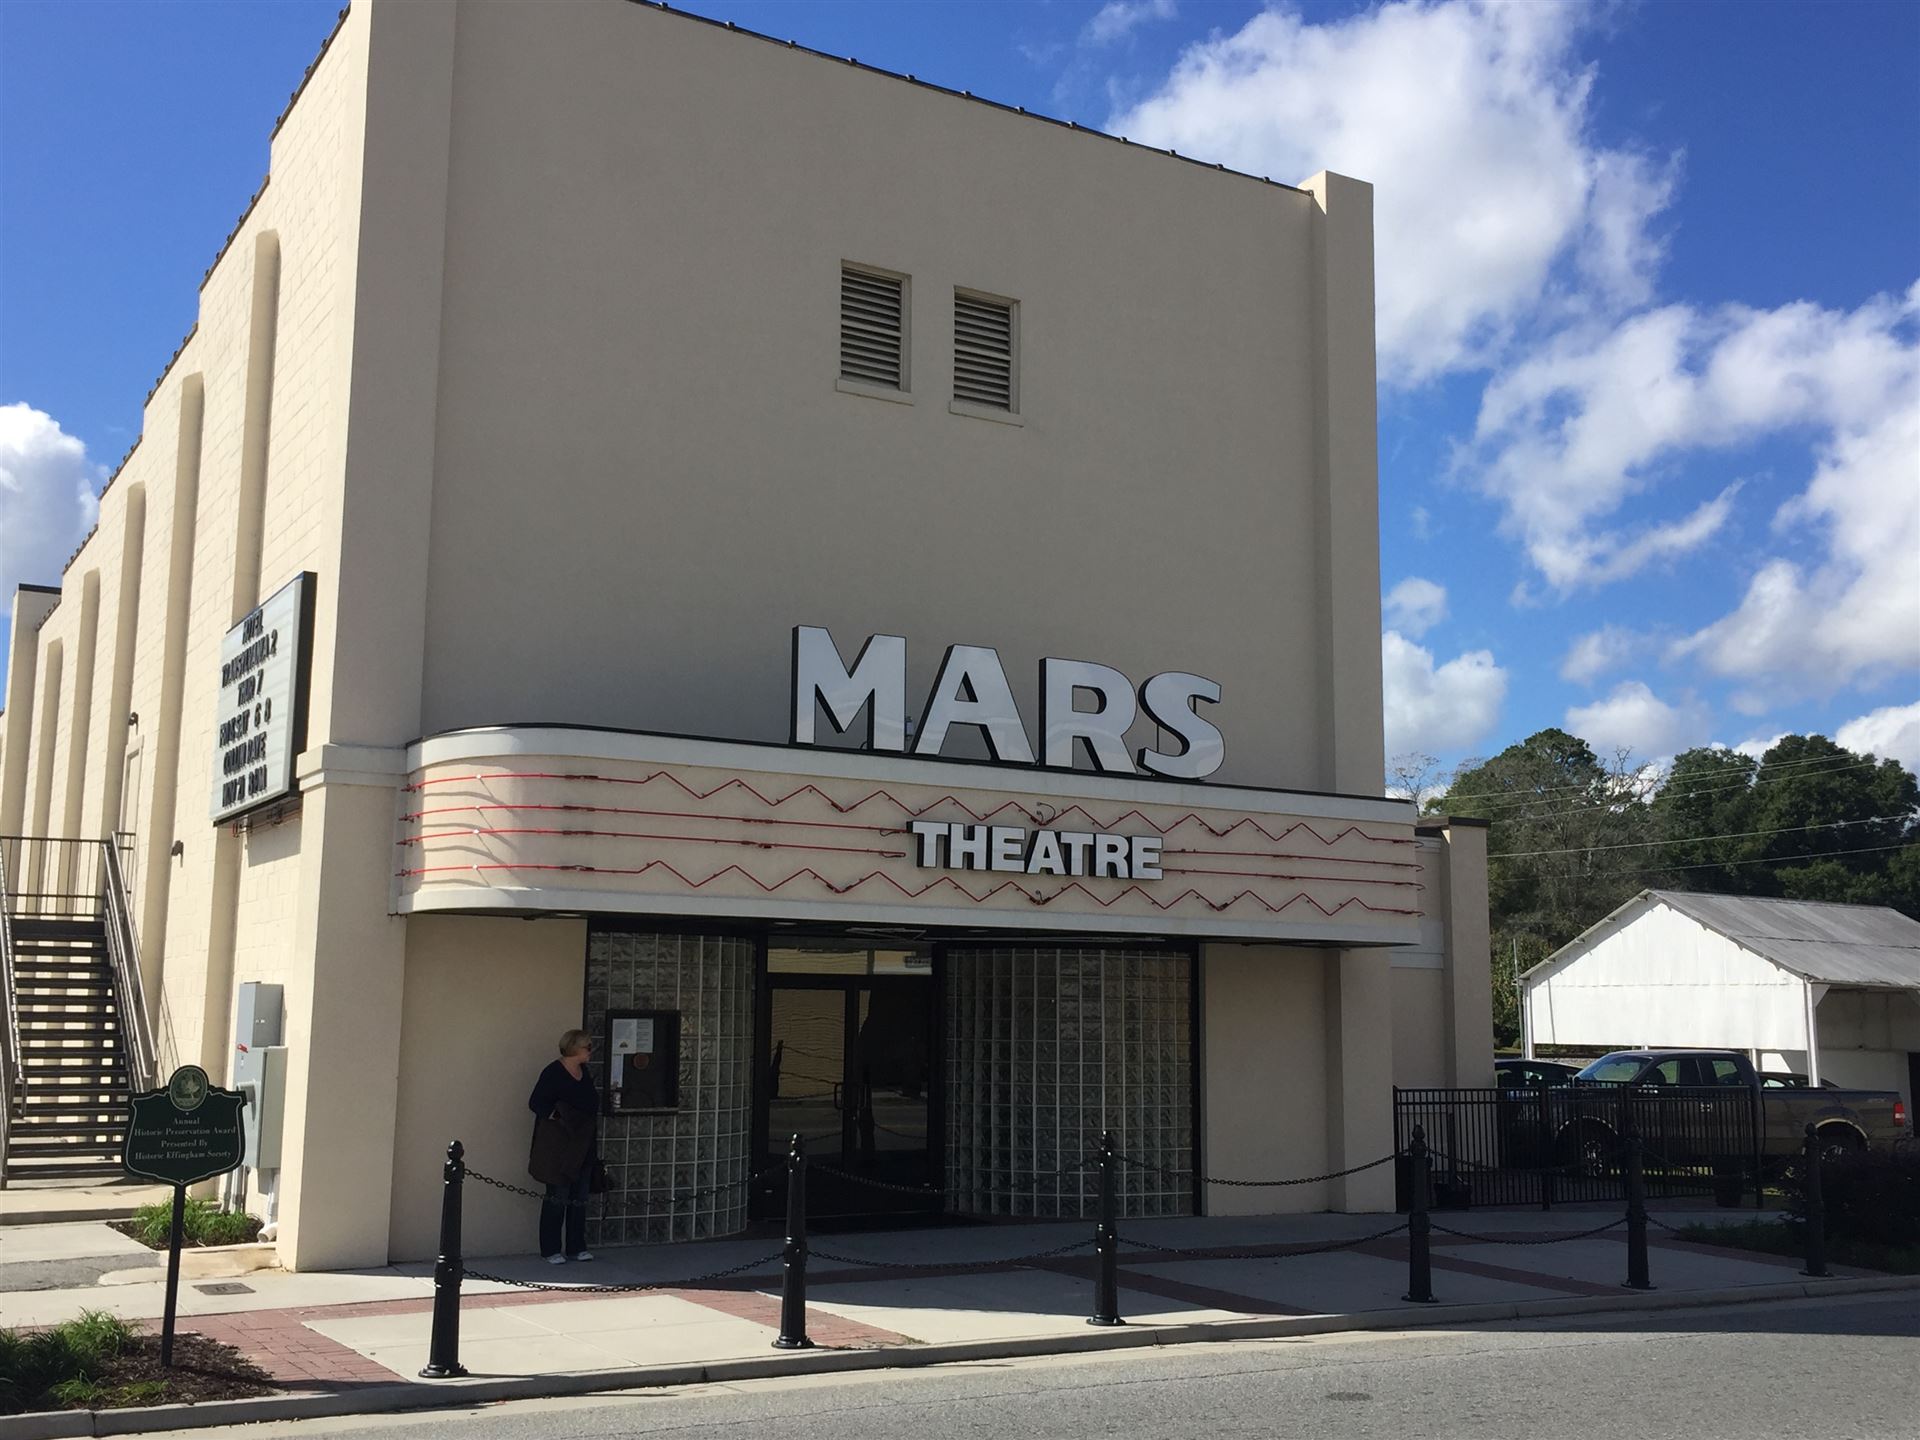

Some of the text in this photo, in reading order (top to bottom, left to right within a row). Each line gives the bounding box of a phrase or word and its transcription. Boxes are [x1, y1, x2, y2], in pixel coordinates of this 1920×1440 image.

[790, 624, 1226, 780] MARS
[254, 702, 262, 729] 6
[906, 820, 1164, 881] THEATRE
[174, 1117, 200, 1125] Annual
[134, 1126, 236, 1137] Historic Preservation Award
[161, 1139, 208, 1148] Presented By
[135, 1150, 231, 1161] Historic Effingham Society
